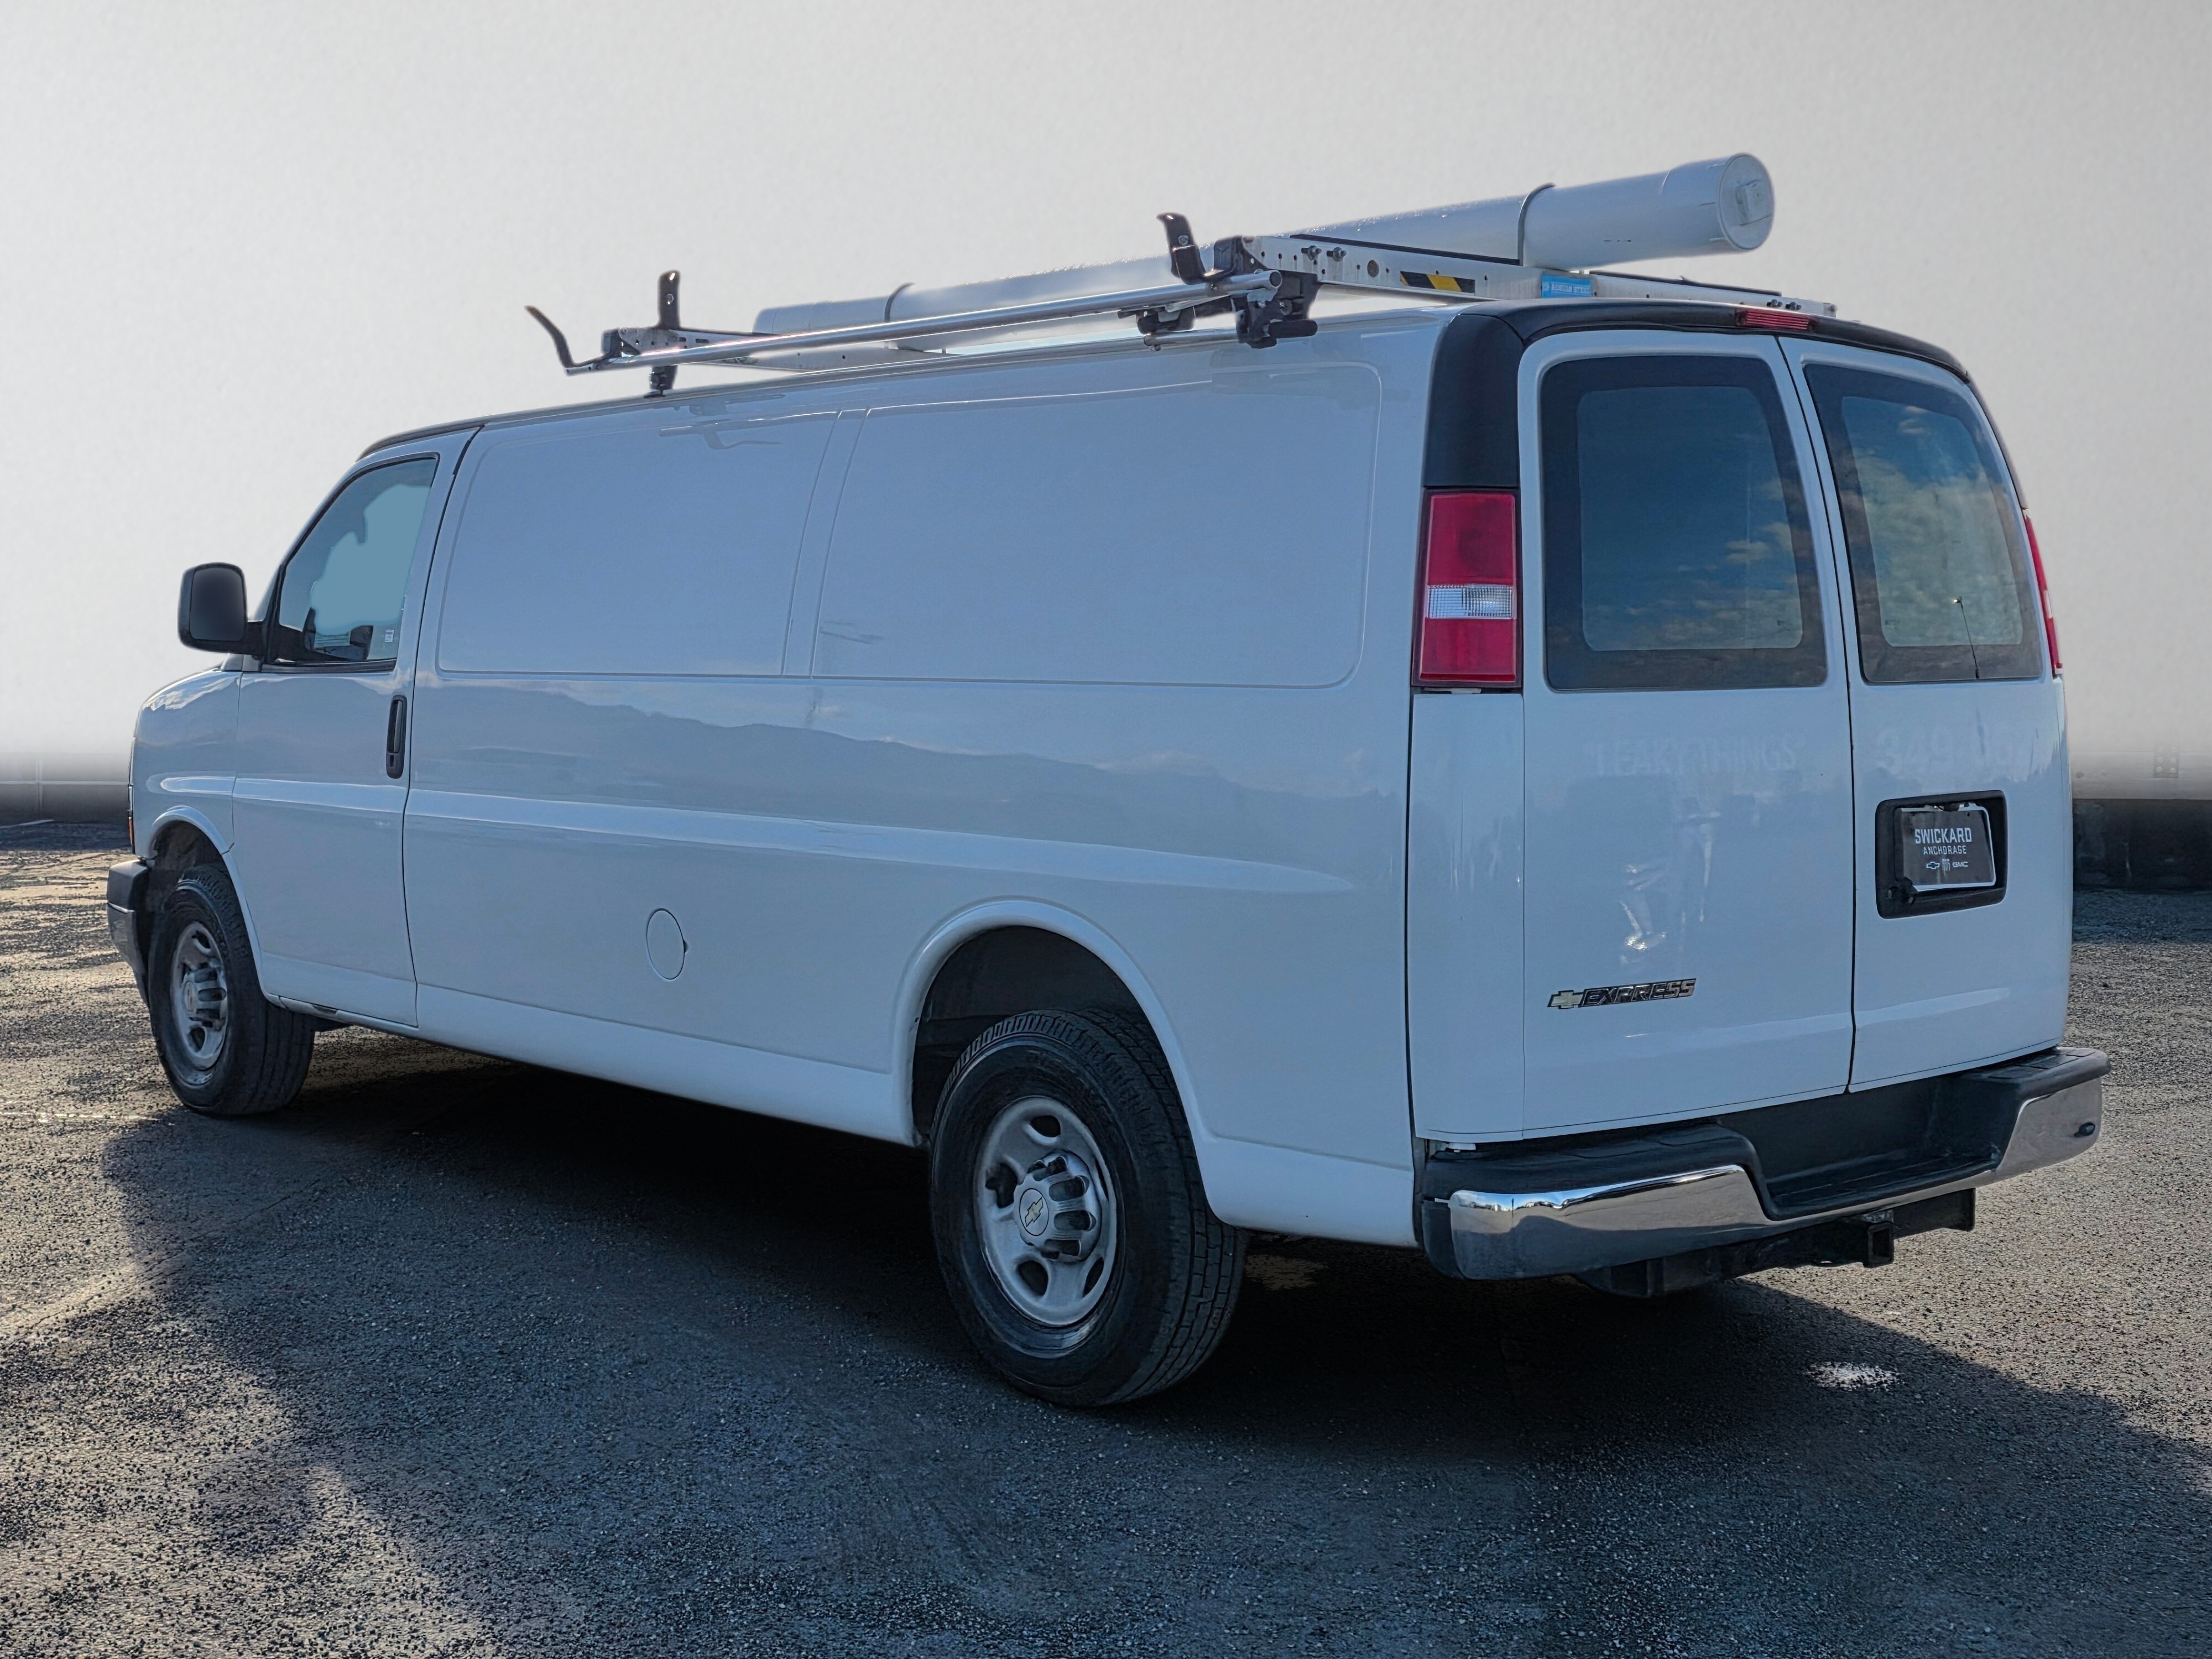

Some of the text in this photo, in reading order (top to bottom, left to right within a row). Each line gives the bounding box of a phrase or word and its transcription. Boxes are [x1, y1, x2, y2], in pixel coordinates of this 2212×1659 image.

[1914, 827, 1972, 844] SWICKARD
[1923, 846, 1967, 855] ANCHORAGE
[1579, 979, 1696, 1007] EXPRESS
